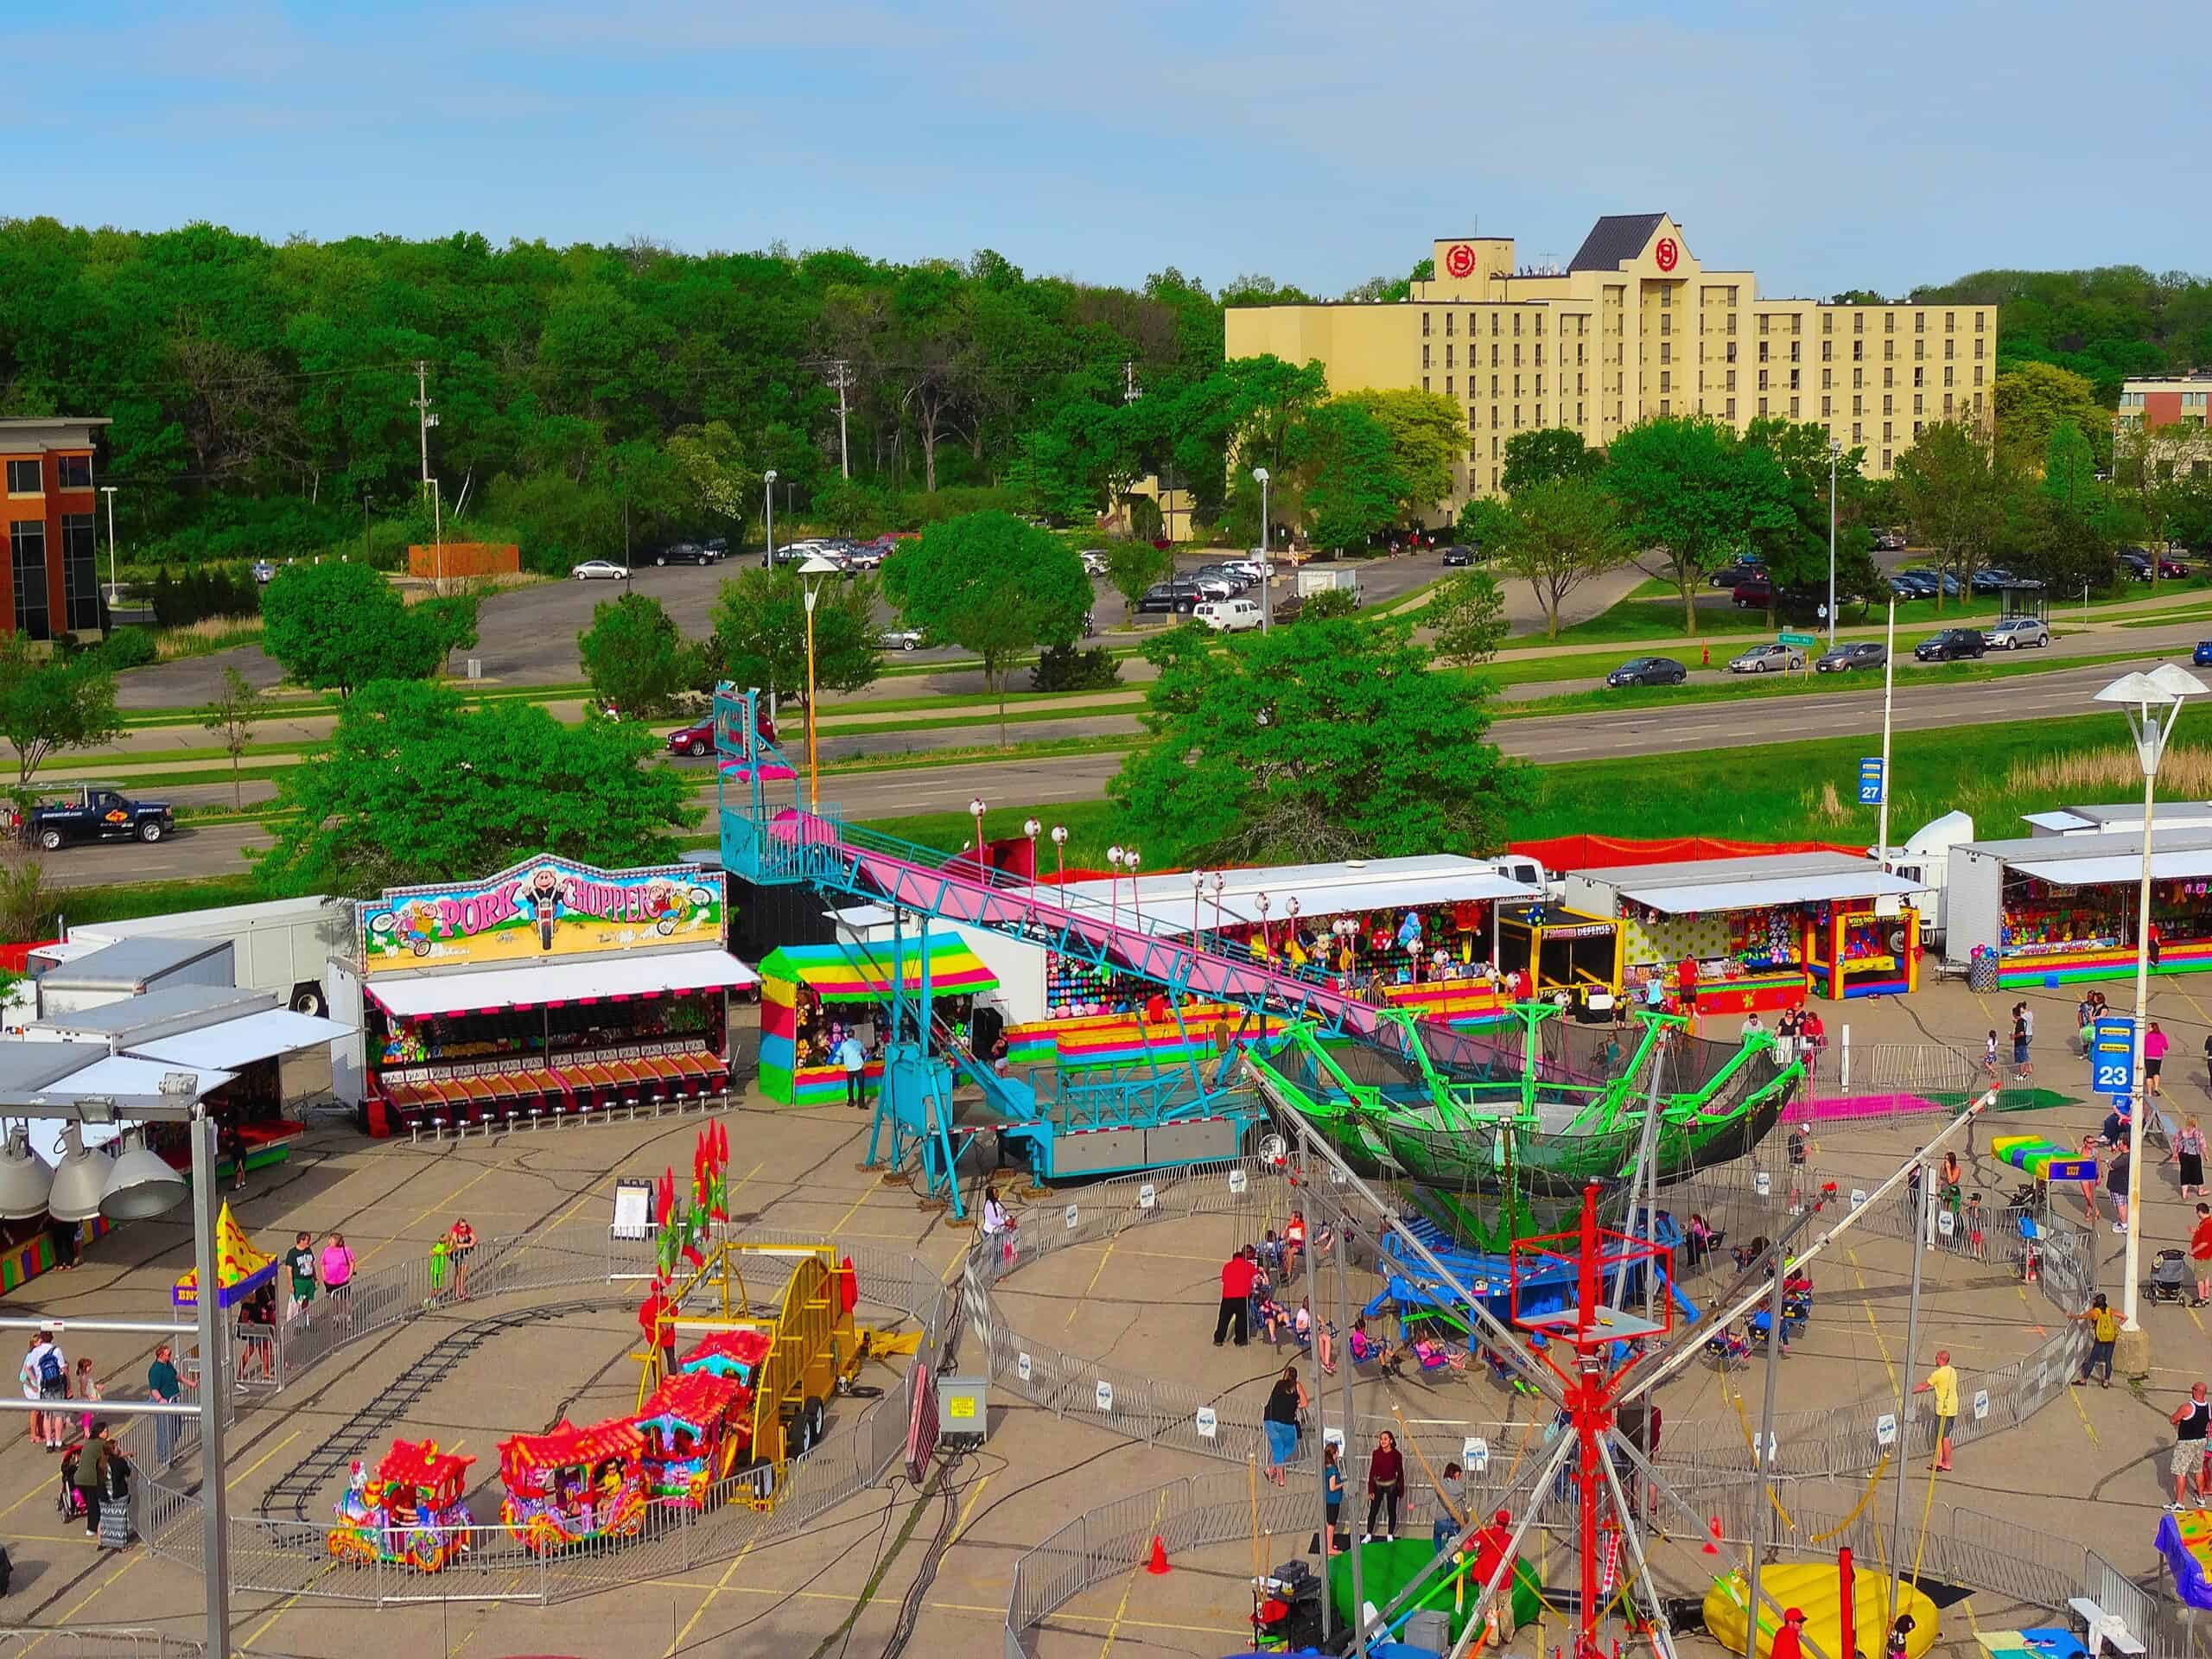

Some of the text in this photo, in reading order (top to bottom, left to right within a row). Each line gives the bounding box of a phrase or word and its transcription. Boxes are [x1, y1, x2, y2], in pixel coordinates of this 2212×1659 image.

[1861, 786, 1879, 799] 27
[438, 876, 661, 938] PORK CHOPPER
[1577, 924, 1611, 937] DEFENSE
[2098, 1065, 2127, 1085] 23
